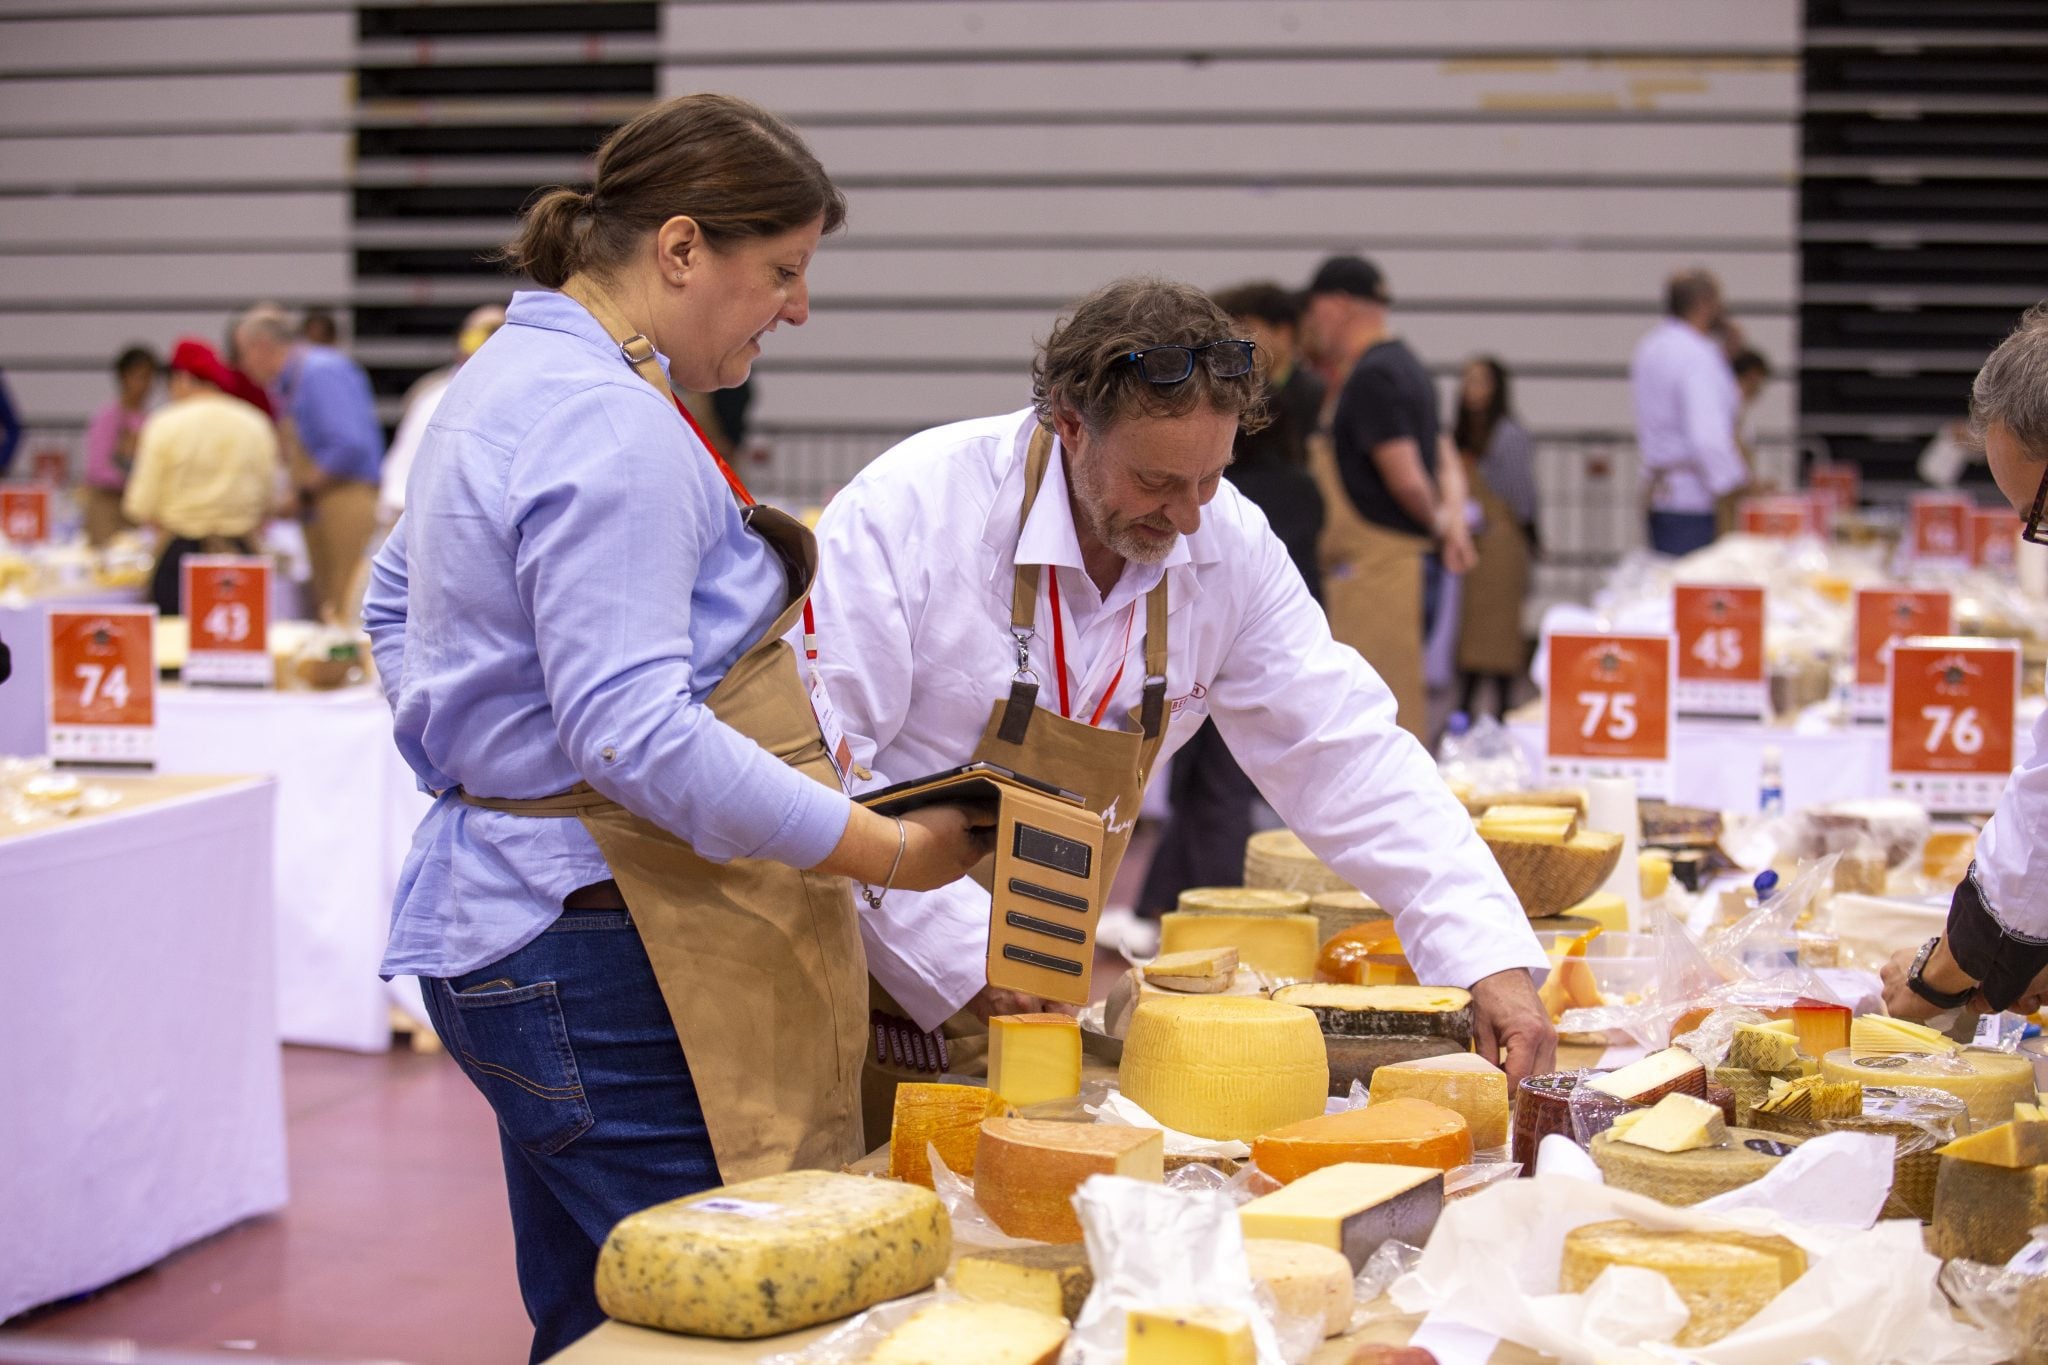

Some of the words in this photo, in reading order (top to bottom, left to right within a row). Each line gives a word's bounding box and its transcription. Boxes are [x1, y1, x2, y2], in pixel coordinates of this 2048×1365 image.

[203, 603, 250, 641] 43
[1691, 628, 1743, 669] 45
[74, 664, 131, 709] 74
[1578, 692, 1638, 739] 75
[1921, 705, 1984, 754] 76
